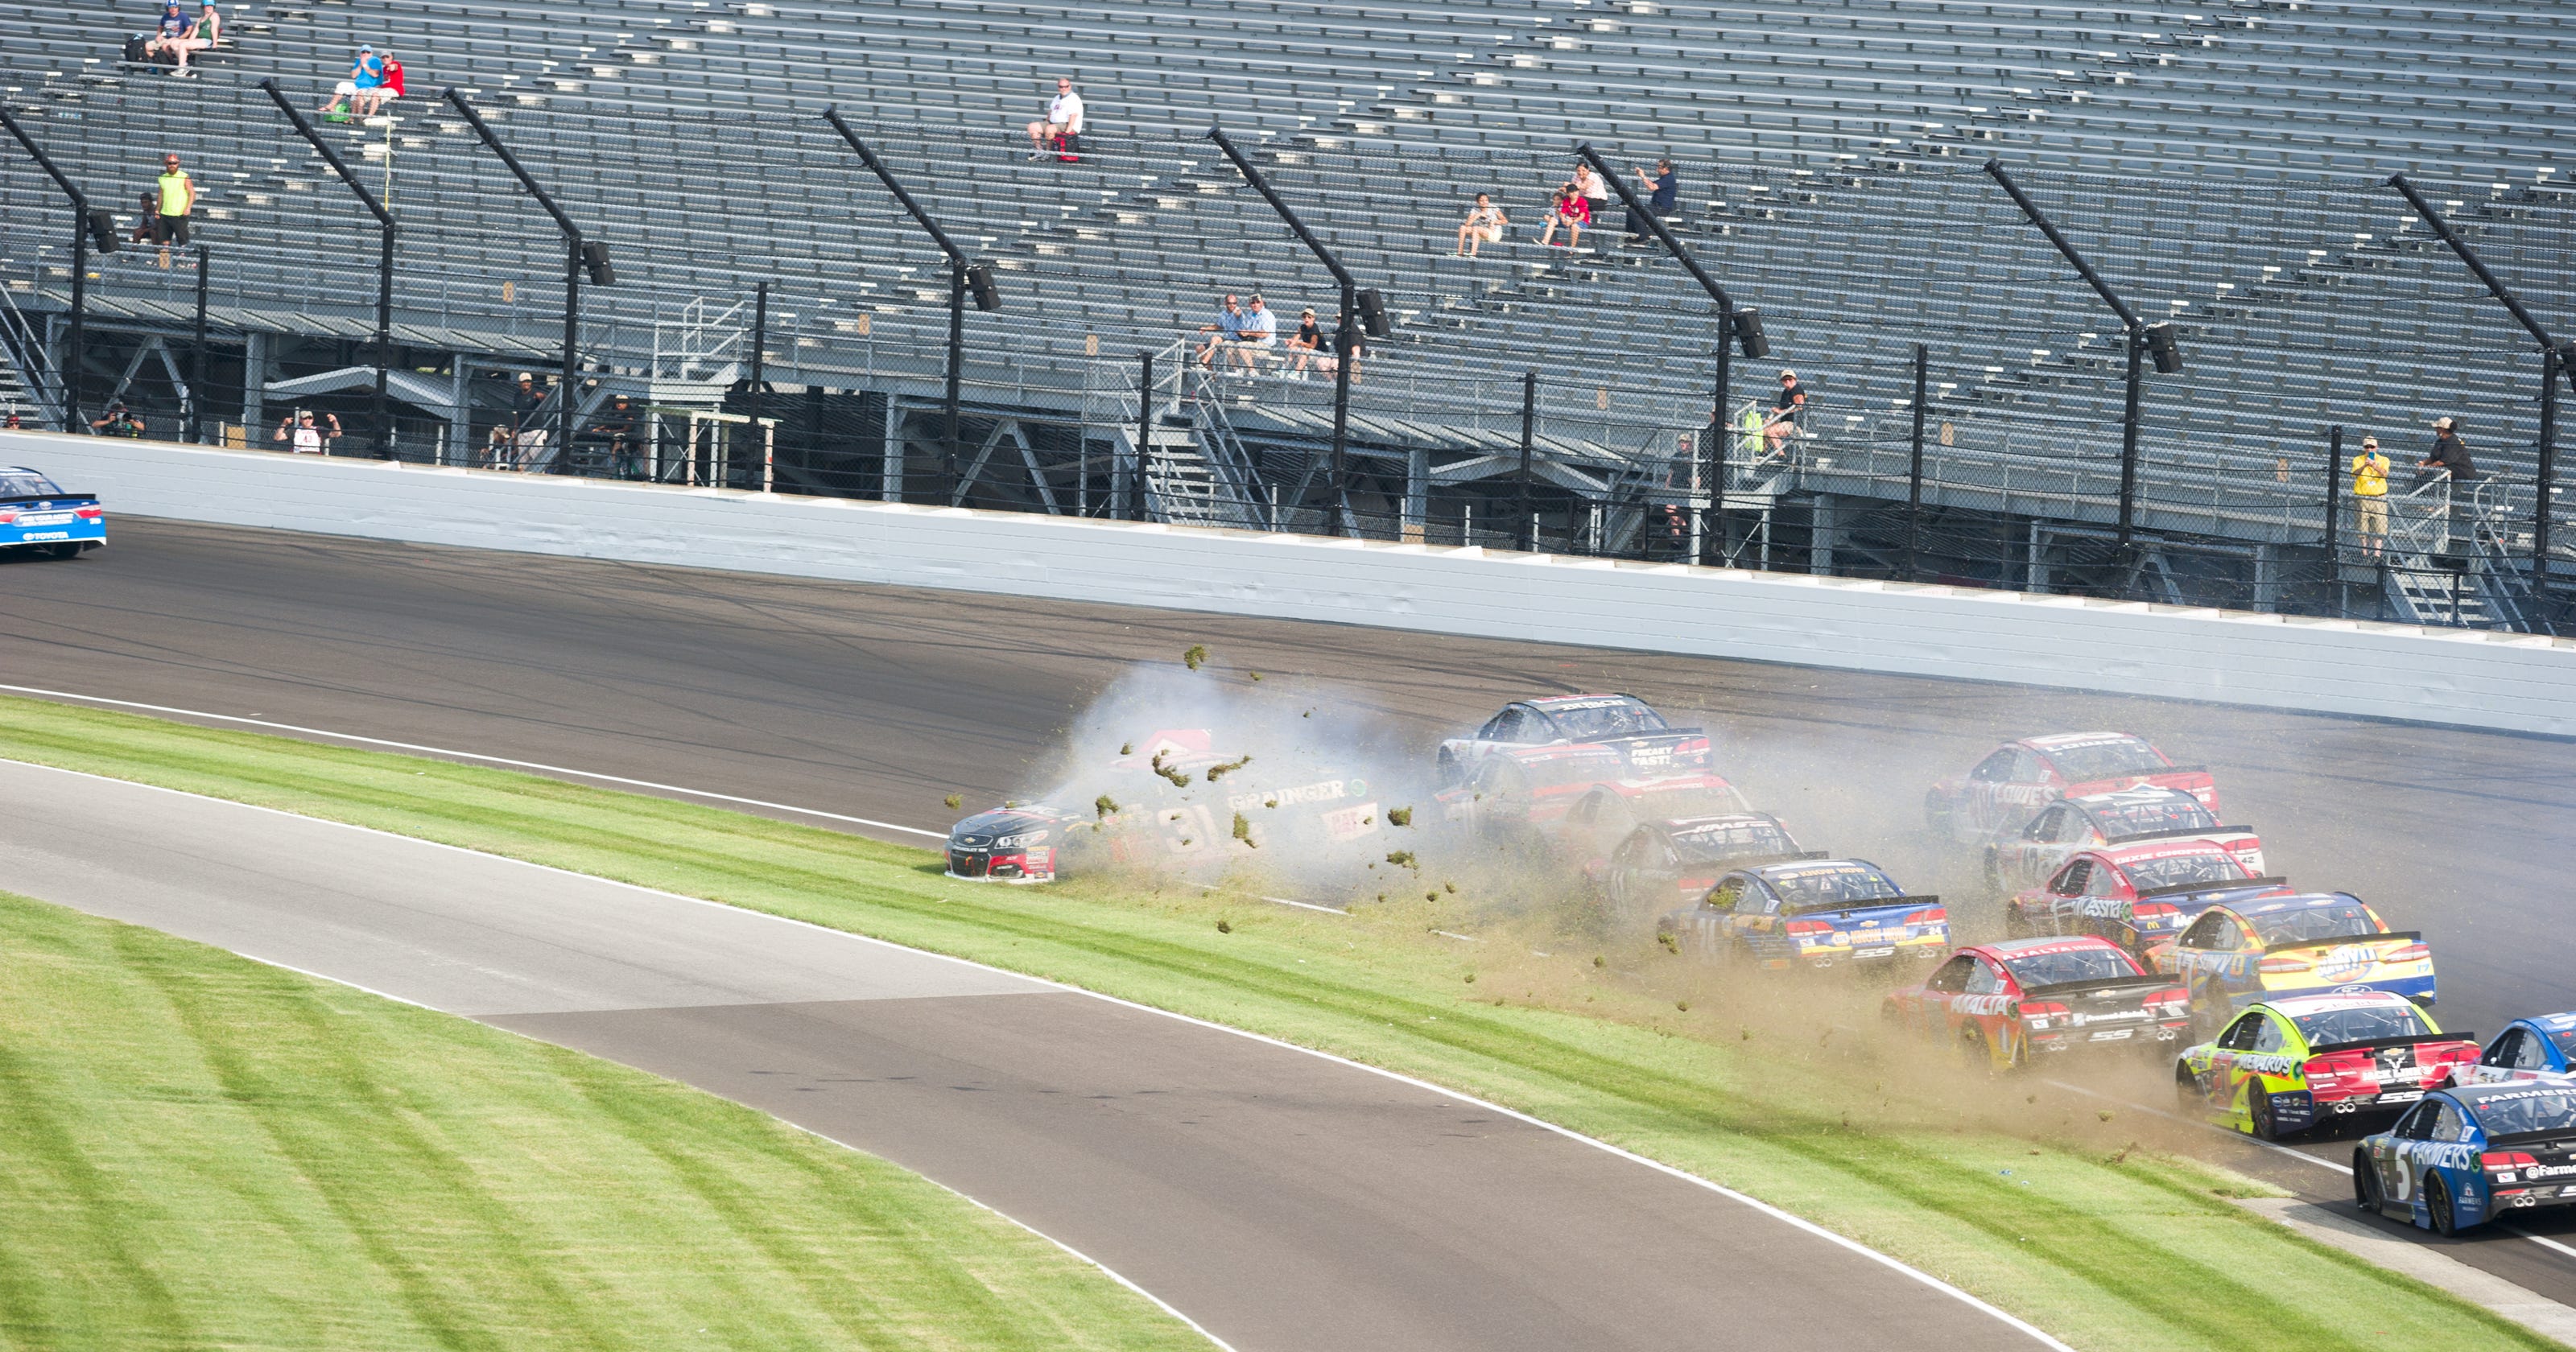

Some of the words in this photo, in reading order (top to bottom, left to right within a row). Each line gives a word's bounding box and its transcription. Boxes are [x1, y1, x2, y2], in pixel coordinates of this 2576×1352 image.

[33, 531, 69, 540] TOYOTA
[1559, 699, 1629, 711] BUSCH
[1631, 747, 1674, 757] FREAKY
[1631, 756, 1672, 766] FAST!
[1228, 780, 1346, 810] GRAINGER
[2198, 793, 2211, 802] 48
[2115, 852, 2153, 864] DIXIE
[2156, 847, 2224, 858] CHOPPER
[2241, 856, 2256, 864] 42
[1798, 868, 1835, 877] KNOW
[1850, 928, 1882, 945] KNOW
[1883, 925, 1908, 942] HOW
[1926, 926, 1942, 936] 24
[1852, 946, 1897, 959] SS
[2002, 946, 2072, 961] AXALTA
[1951, 995, 2013, 1016] AXALTA
[2087, 1028, 2135, 1042] SS
[2238, 1053, 2292, 1074] MENARDS
[2362, 1070, 2392, 1082] JACK
[2376, 1090, 2425, 1104] SS
[2476, 1088, 2576, 1104] FARMERS
[2411, 1141, 2476, 1171] FARMERS
[2395, 1142, 2413, 1201] 5
